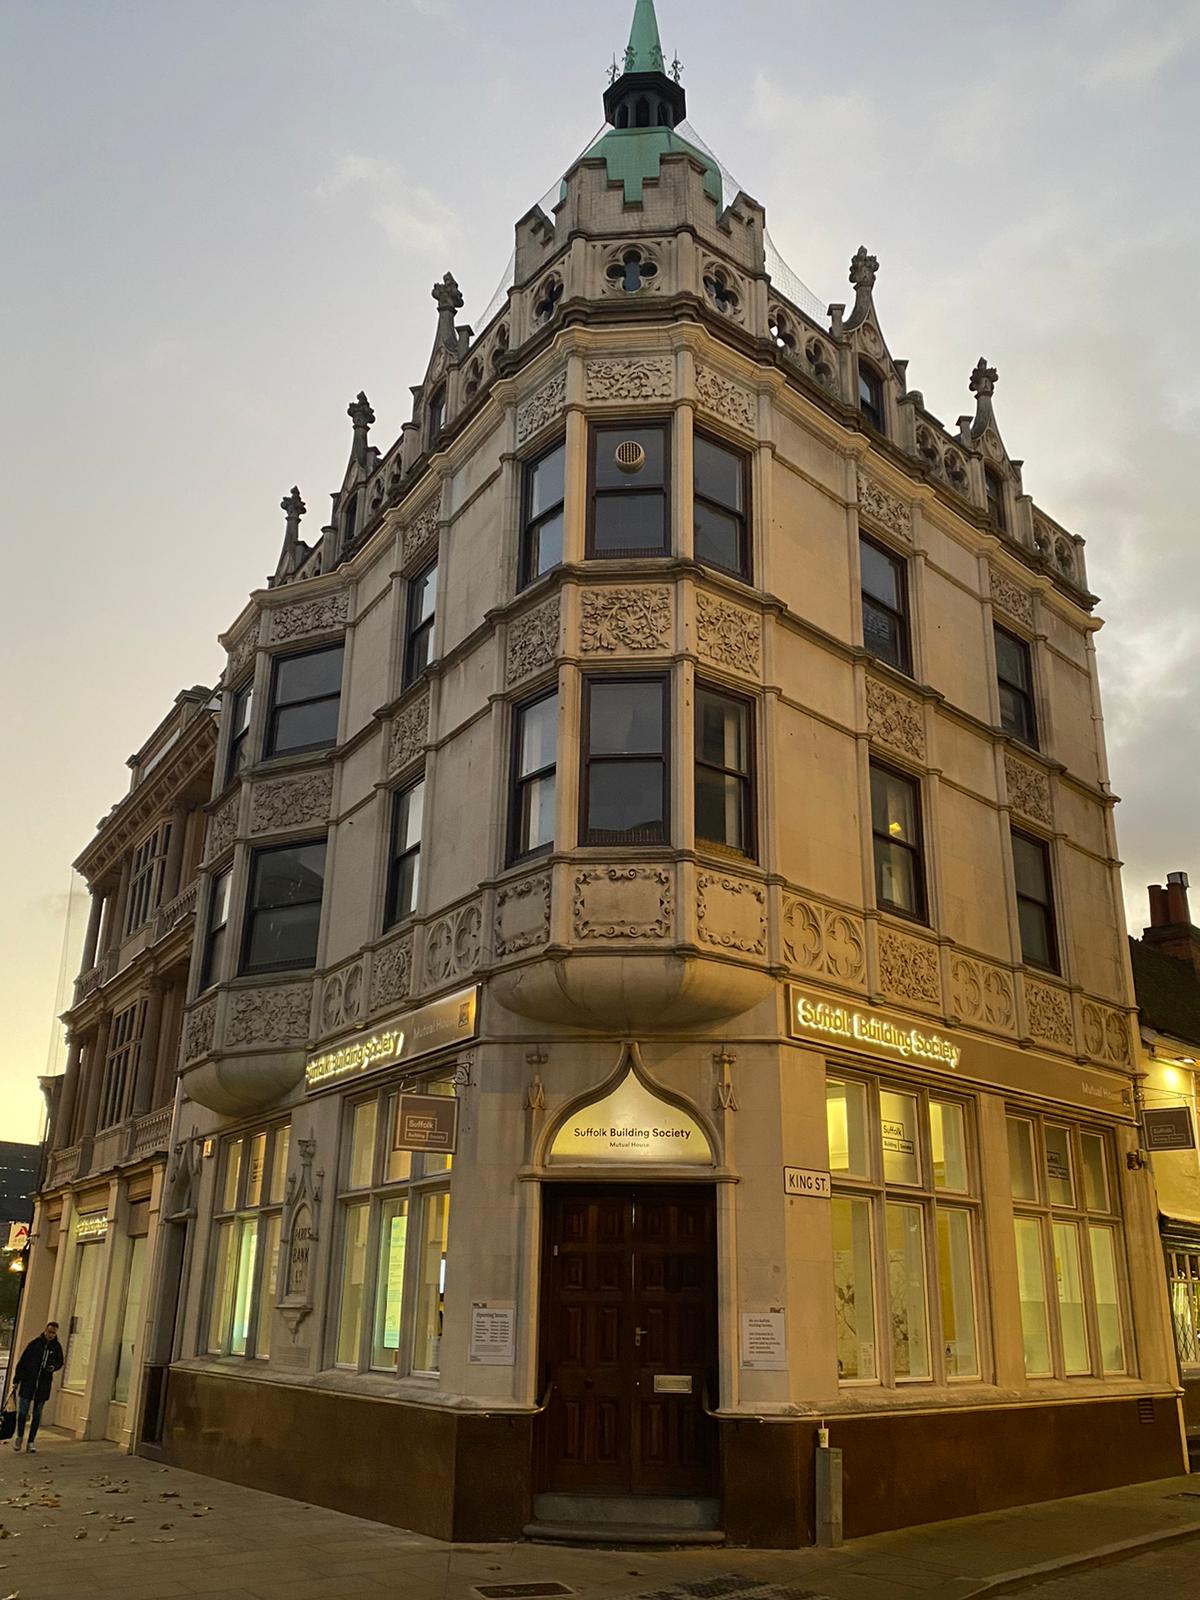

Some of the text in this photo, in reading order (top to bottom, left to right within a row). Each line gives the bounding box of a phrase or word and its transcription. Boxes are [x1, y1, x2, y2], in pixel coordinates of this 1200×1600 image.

[797, 999, 962, 1068] Suffolk Building Society
[408, 1119, 434, 1129] Suffolk
[574, 1127, 691, 1139] Suffolk Building Society
[789, 1173, 829, 1192] KING ST.
